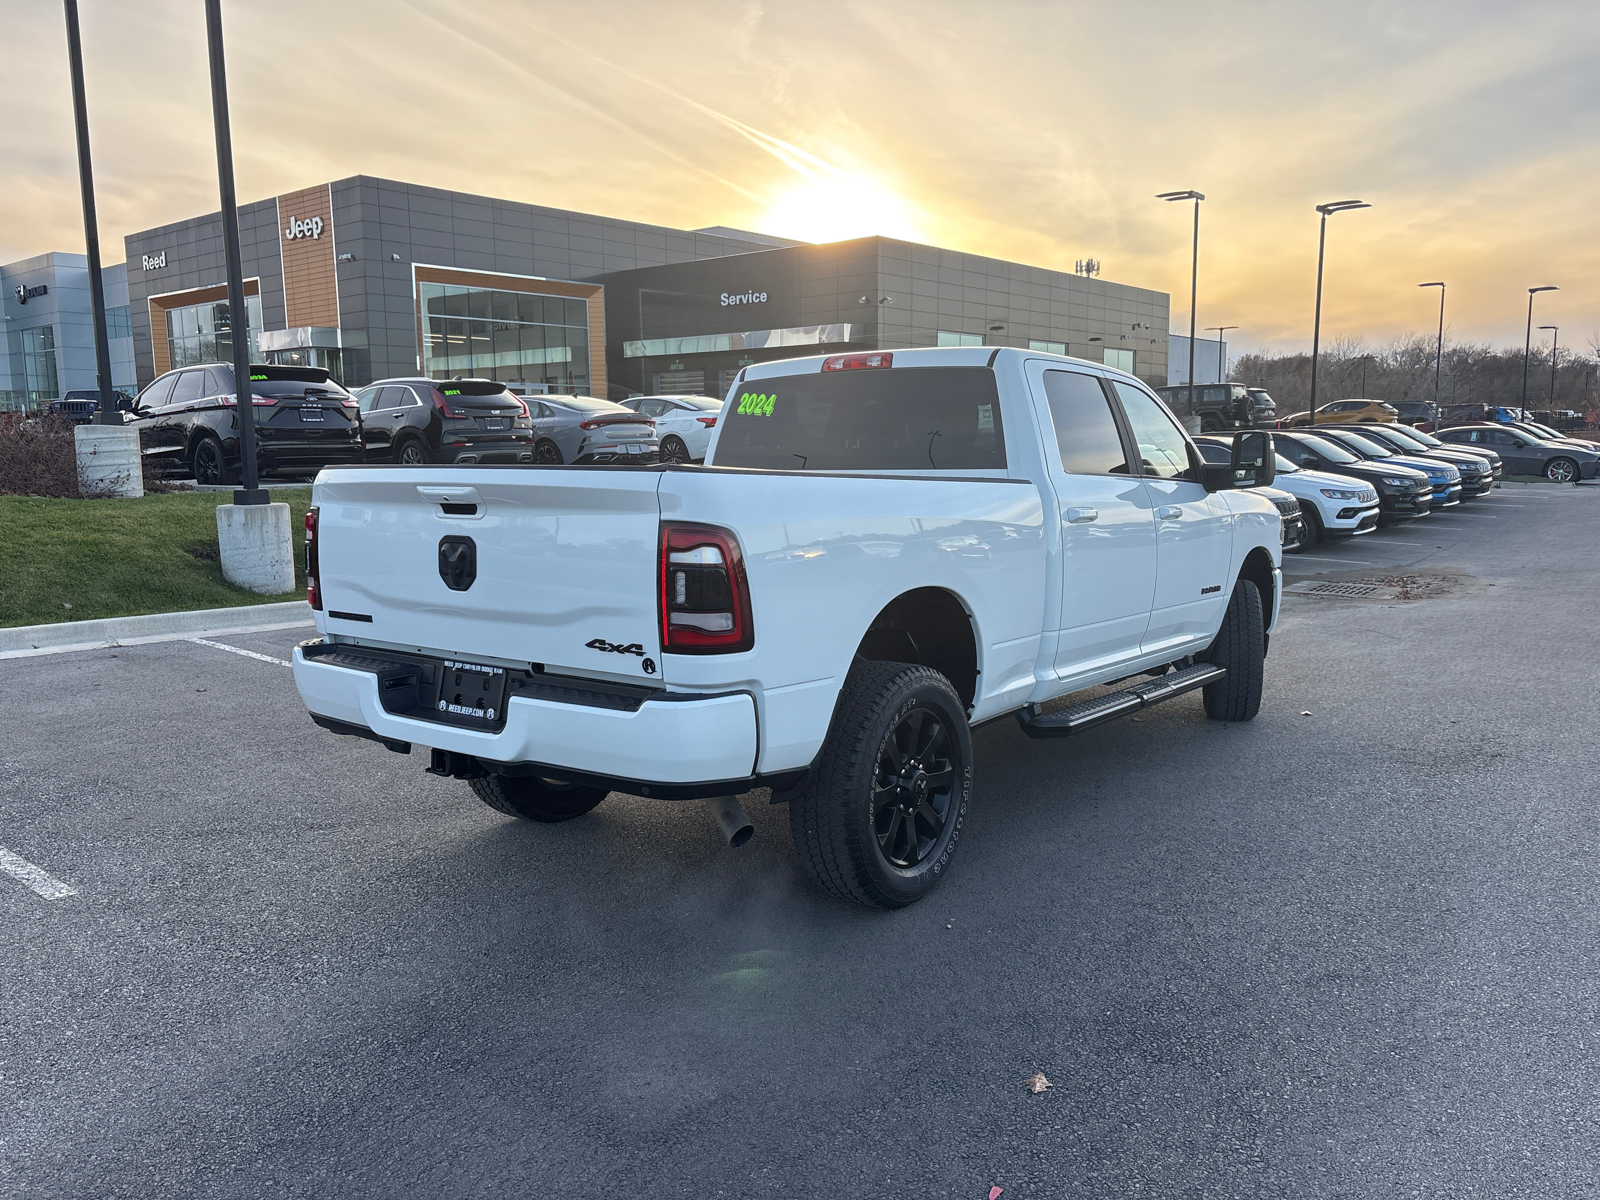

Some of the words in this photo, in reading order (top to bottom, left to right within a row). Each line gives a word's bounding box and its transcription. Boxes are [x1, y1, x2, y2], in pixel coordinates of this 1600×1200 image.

[285, 215, 323, 240] Jeep
[142, 250, 167, 271] Reed
[720, 290, 768, 306] Service
[737, 392, 777, 416] 2024
[584, 638, 647, 657] 4x4
[444, 660, 454, 668] REED
[447, 704, 485, 718] REEDJEEP.COM
